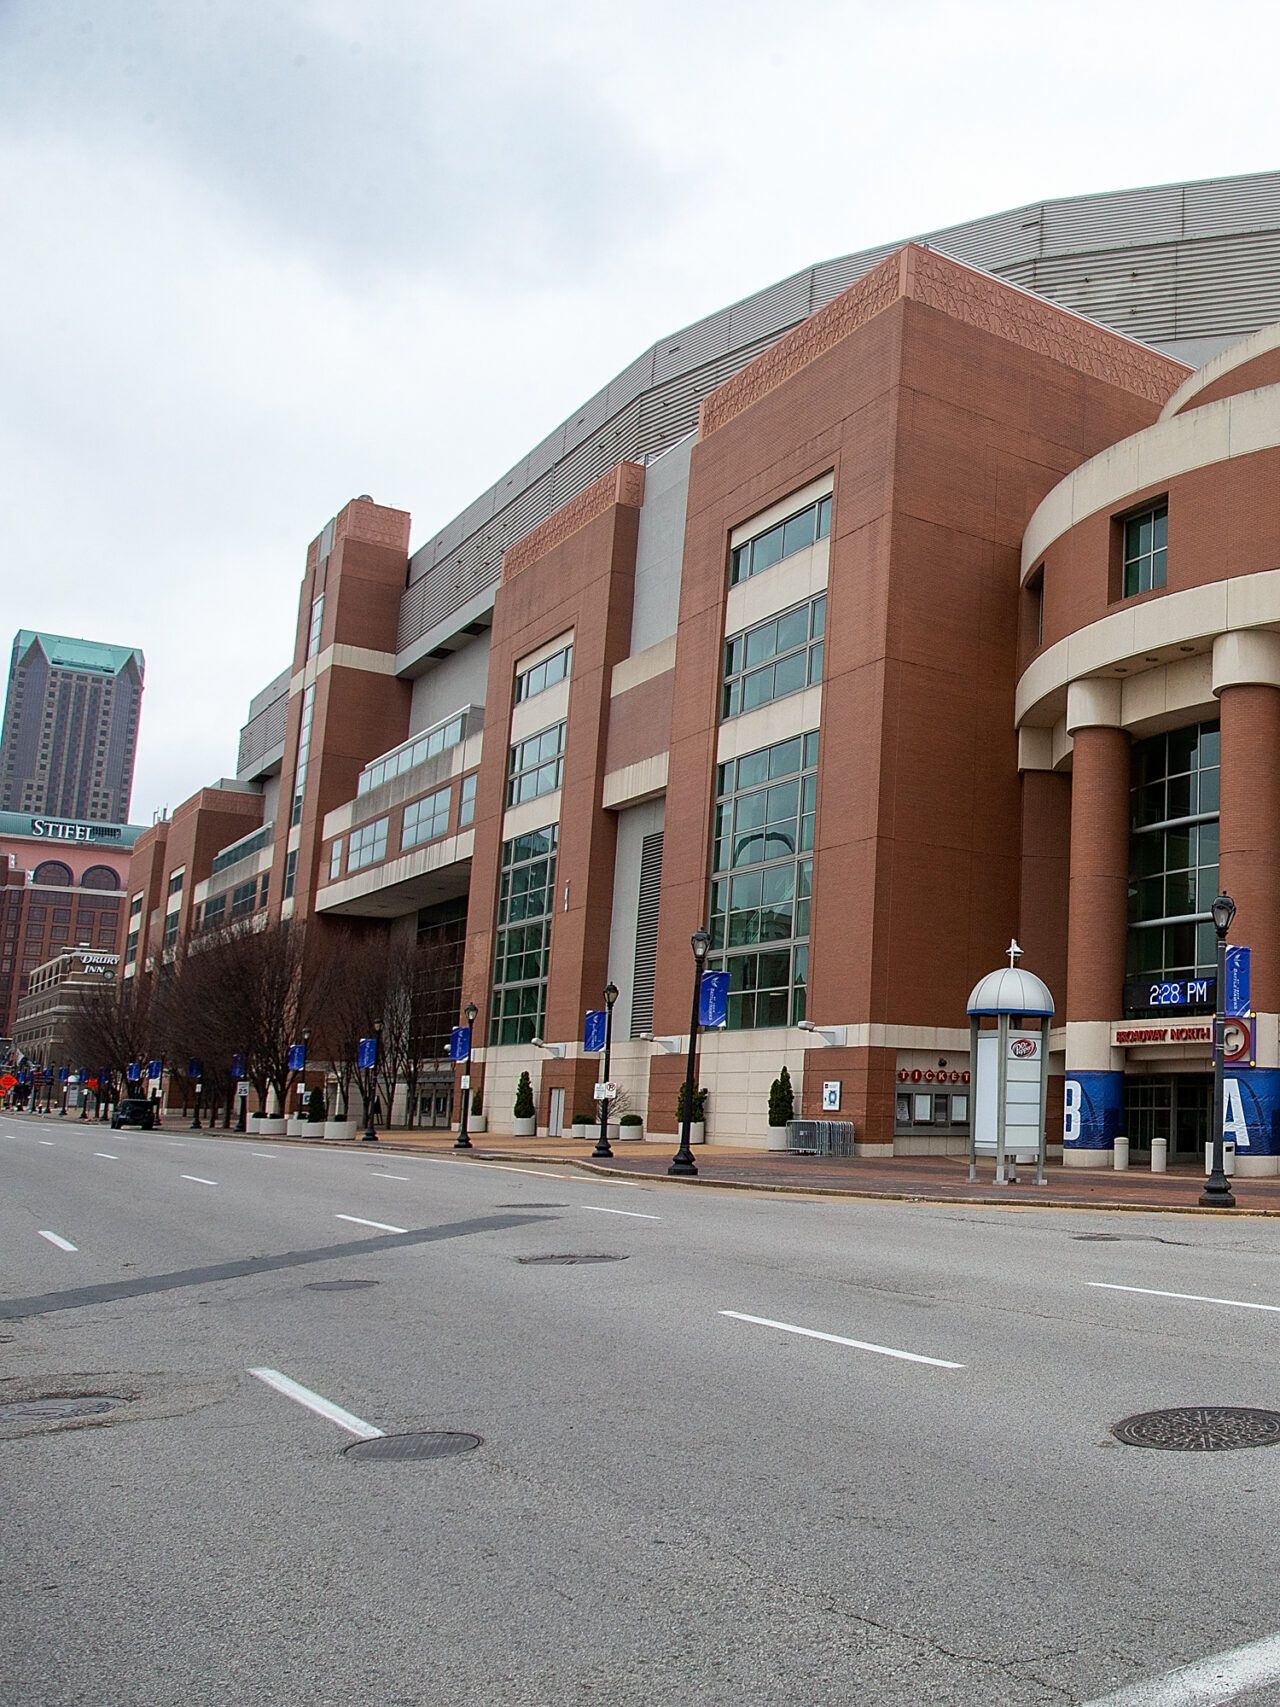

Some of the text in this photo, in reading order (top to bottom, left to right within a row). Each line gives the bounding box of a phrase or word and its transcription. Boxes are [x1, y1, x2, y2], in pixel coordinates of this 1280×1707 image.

[32, 819, 96, 841] STIFEL
[81, 955, 120, 965] DRURY
[84, 965, 105, 973] INN
[1149, 981, 1207, 1006] 2:28 PM
[1170, 1027, 1211, 1041] NORTH
[1224, 1027, 1239, 1052] C
[1064, 1080, 1082, 1141] B
[1223, 1078, 1250, 1146] A
